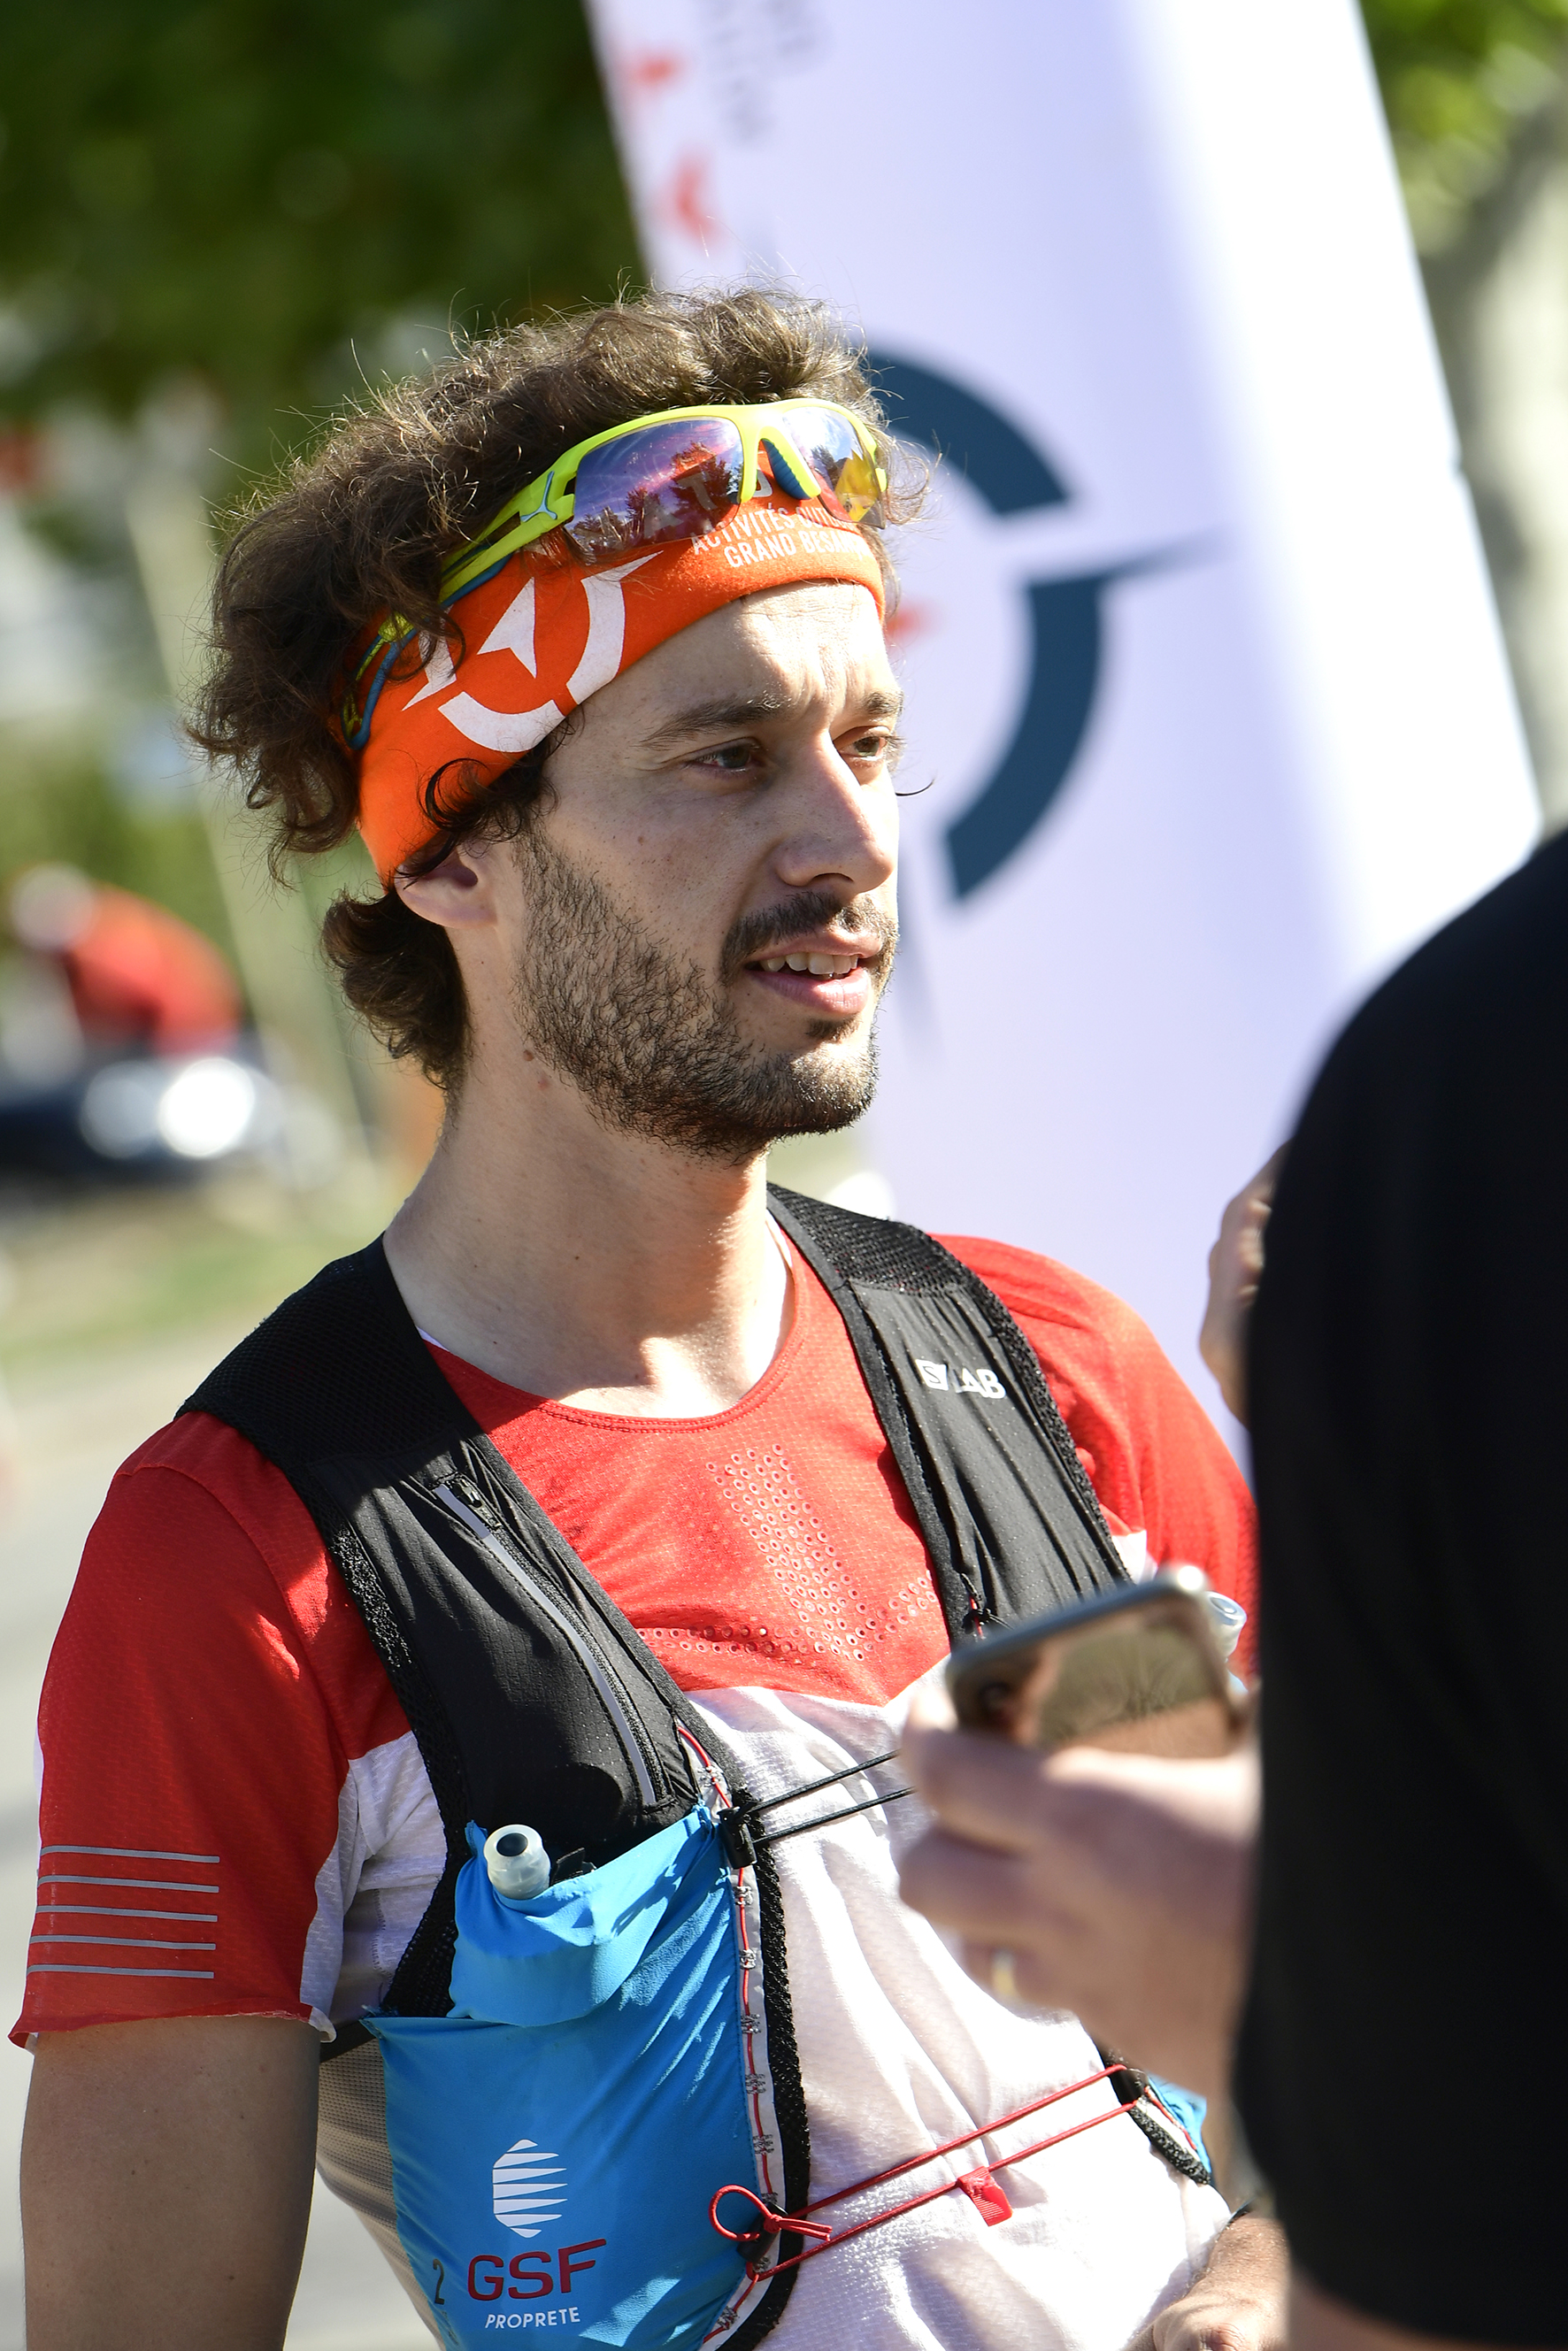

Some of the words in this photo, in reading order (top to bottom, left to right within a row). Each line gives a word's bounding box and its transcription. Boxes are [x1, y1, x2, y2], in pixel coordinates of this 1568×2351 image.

[724, 533, 796, 567] GRAND
[467, 2238, 607, 2301] GSF
[485, 2306, 580, 2329] PROPRETE
